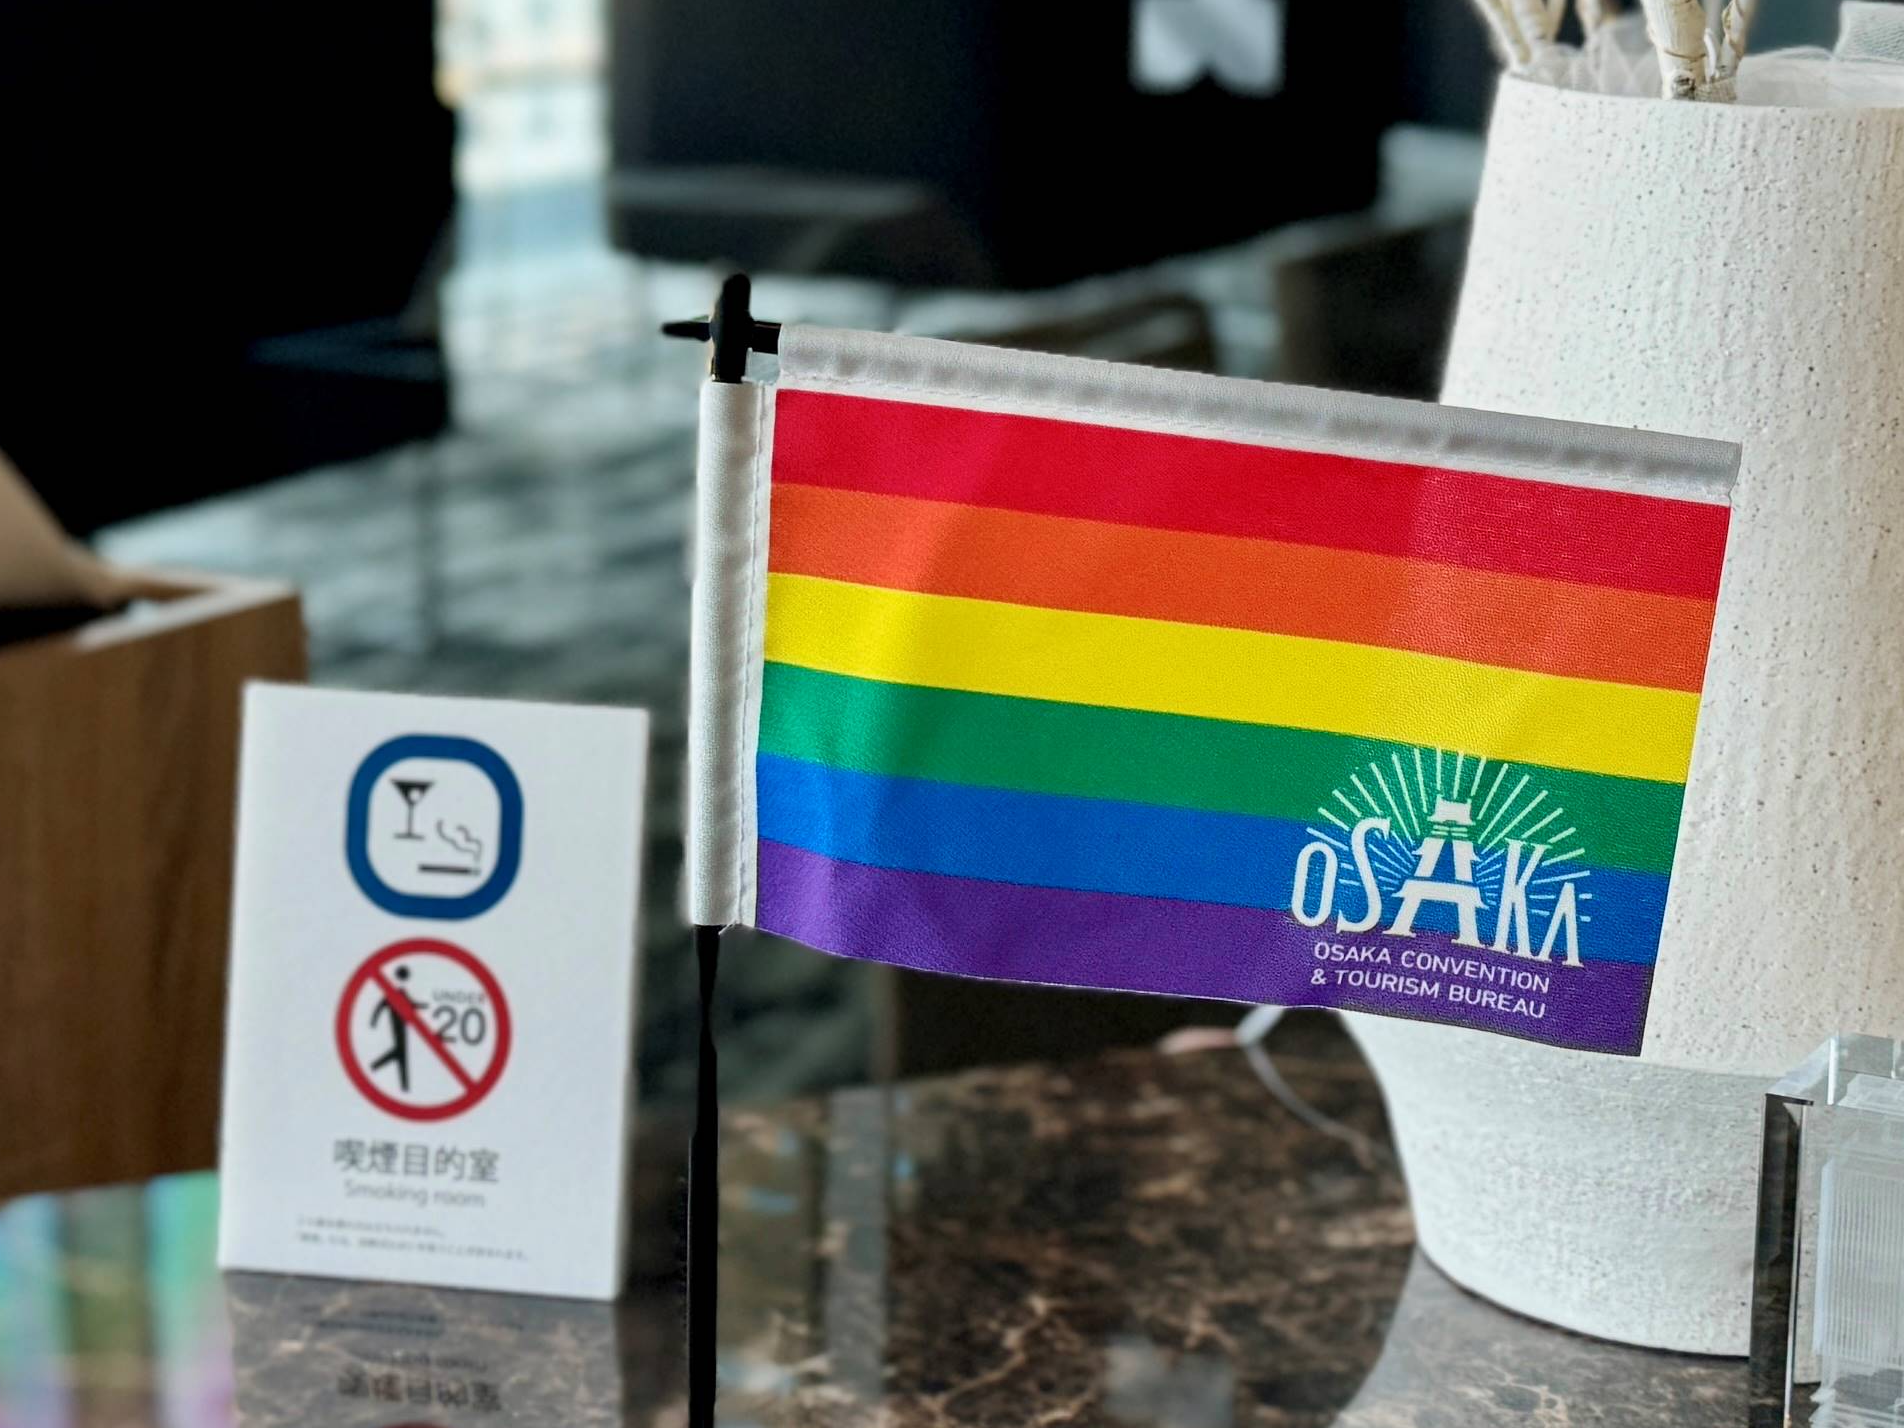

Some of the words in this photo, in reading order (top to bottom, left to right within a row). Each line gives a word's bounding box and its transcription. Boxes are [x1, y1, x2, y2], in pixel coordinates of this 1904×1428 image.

[1290, 794, 1584, 968] OSAKA
[1313, 940, 1392, 967] OSAKA
[1400, 948, 1550, 995] CONVENTION
[1310, 969, 1327, 987] &
[1335, 969, 1440, 1001] TOURISM
[1448, 984, 1548, 1020] BUREAU
[431, 1004, 486, 1047] 20
[333, 1138, 501, 1183] 喫煙目的室
[344, 1178, 429, 1207] Smoking
[432, 1188, 486, 1208] room
